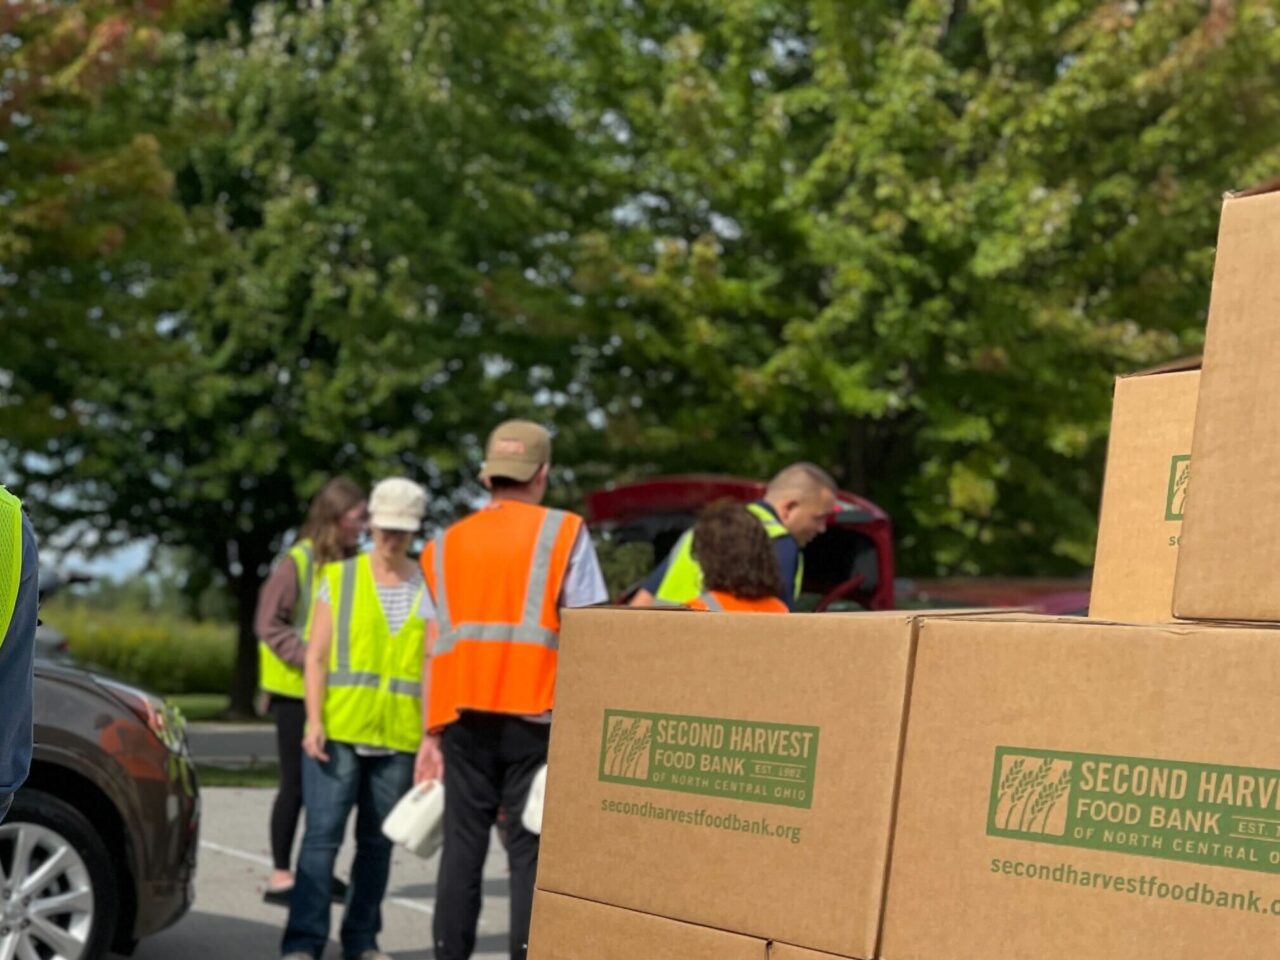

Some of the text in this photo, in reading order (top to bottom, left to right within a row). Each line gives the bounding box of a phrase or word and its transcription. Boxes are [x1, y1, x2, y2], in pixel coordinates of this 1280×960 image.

[656, 718, 813, 759] SECOND HARVEST
[654, 749, 695, 770] FOOD
[700, 753, 746, 776] BANK
[1079, 760, 1188, 800] SECOND
[652, 772, 806, 801] OF NORTH CENTRAL OHIO
[601, 798, 801, 844] secondharvestfoodbank.org
[1075, 798, 1269, 836] FOOD BANK EST.
[1073, 827, 1094, 840] OF
[1103, 830, 1163, 850] NORTH
[1173, 838, 1259, 862] CENTRAL
